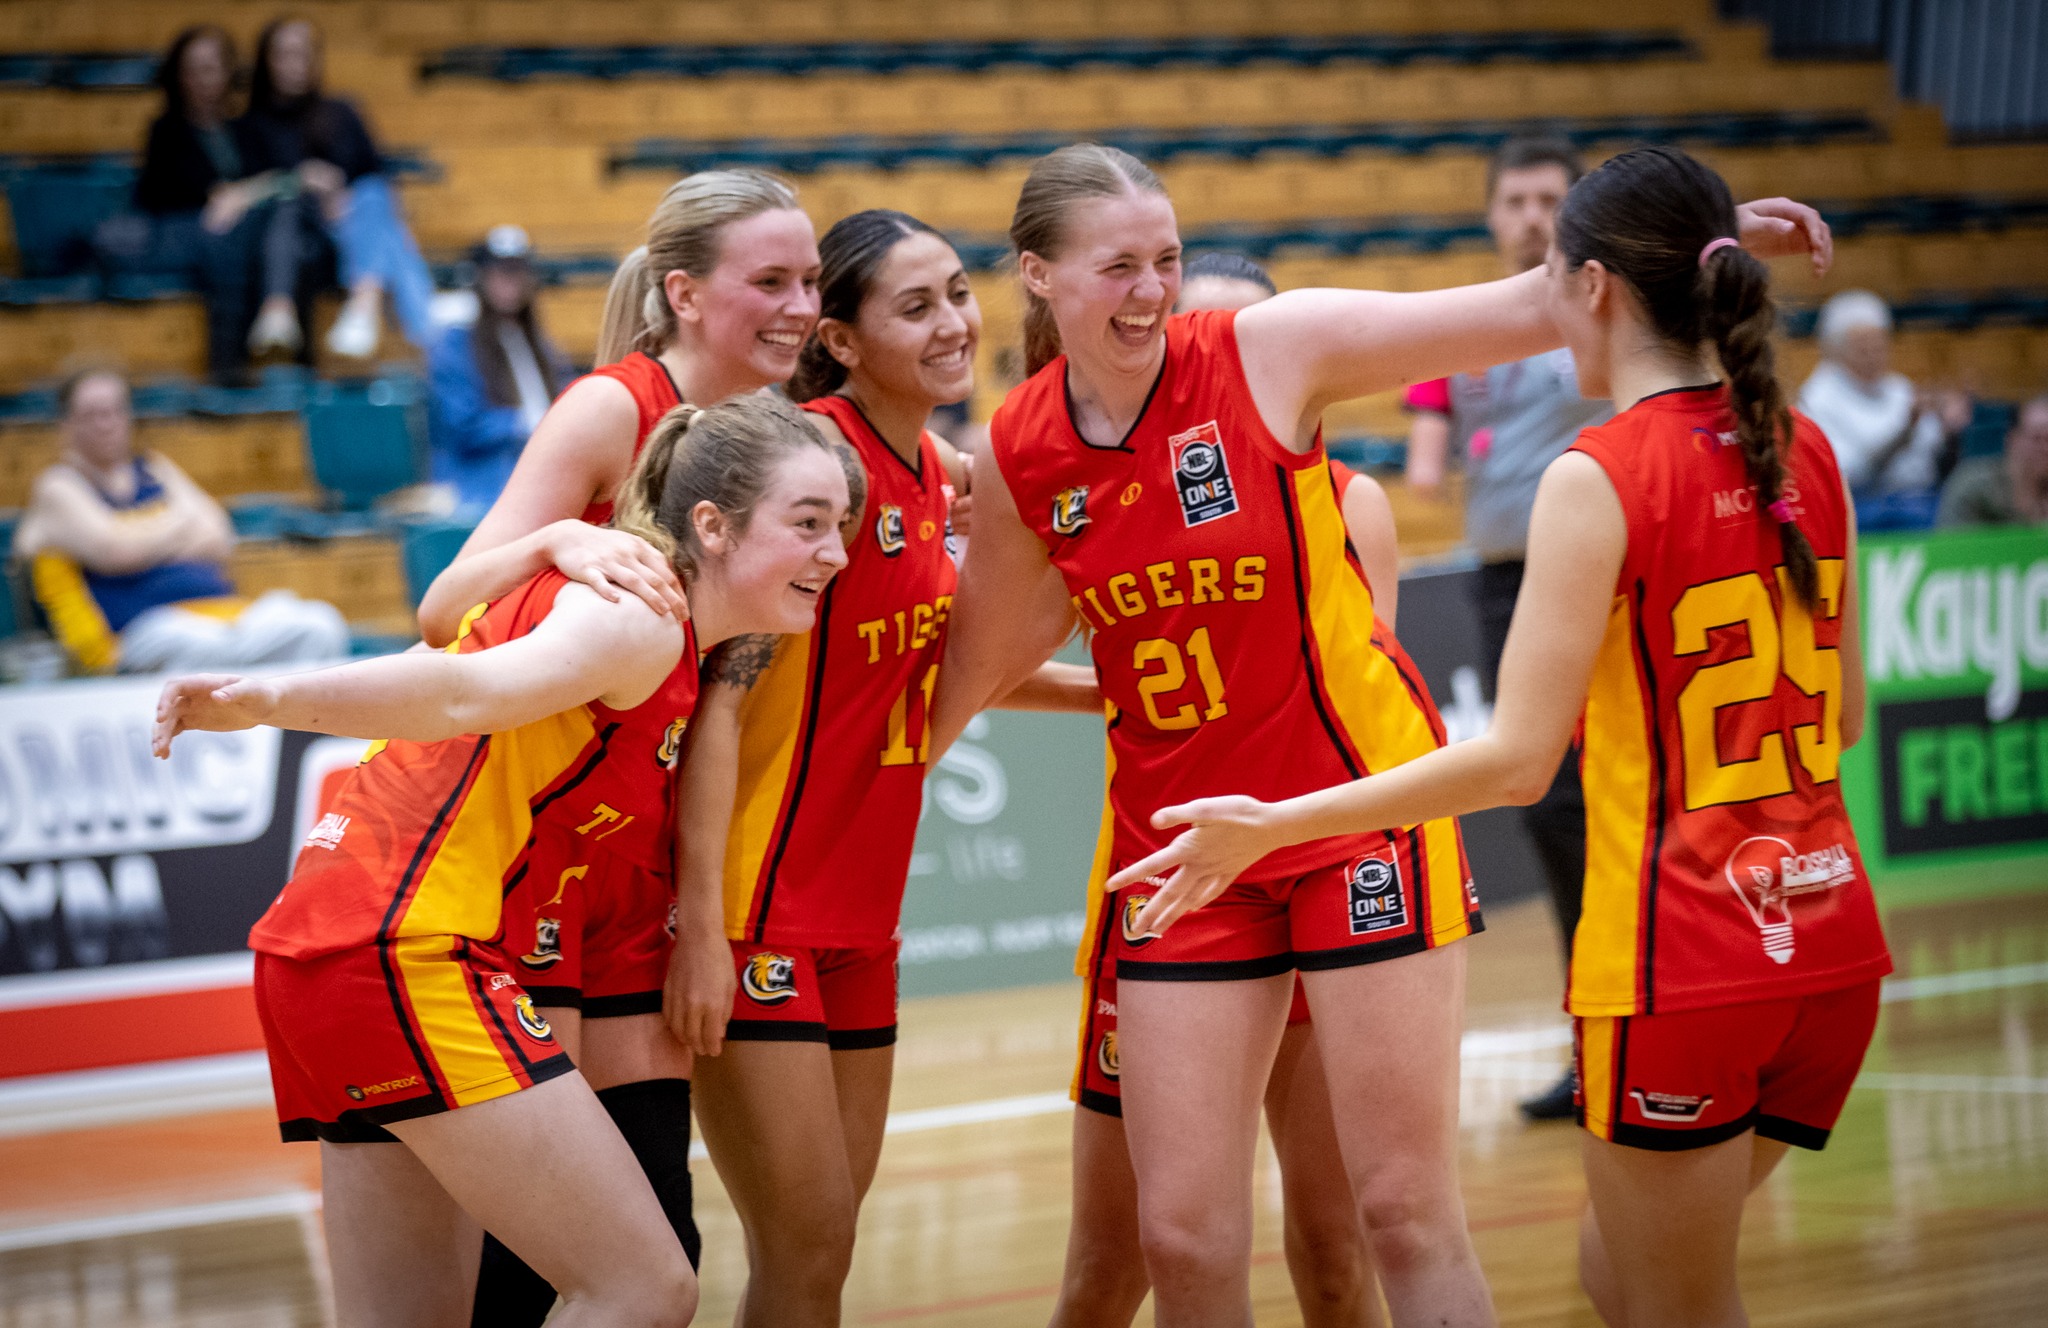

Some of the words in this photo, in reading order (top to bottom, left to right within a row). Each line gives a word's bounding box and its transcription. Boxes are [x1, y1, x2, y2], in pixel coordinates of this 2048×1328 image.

[1186, 451, 1209, 470] NBL
[1185, 477, 1227, 506] ONE
[1072, 555, 1267, 633] IGERS
[1132, 625, 1229, 731] 21
[1671, 556, 1844, 812] 25
[1361, 867, 1383, 884] NBL
[1355, 893, 1398, 916] ONE
[362, 1075, 419, 1096] MATRIX
